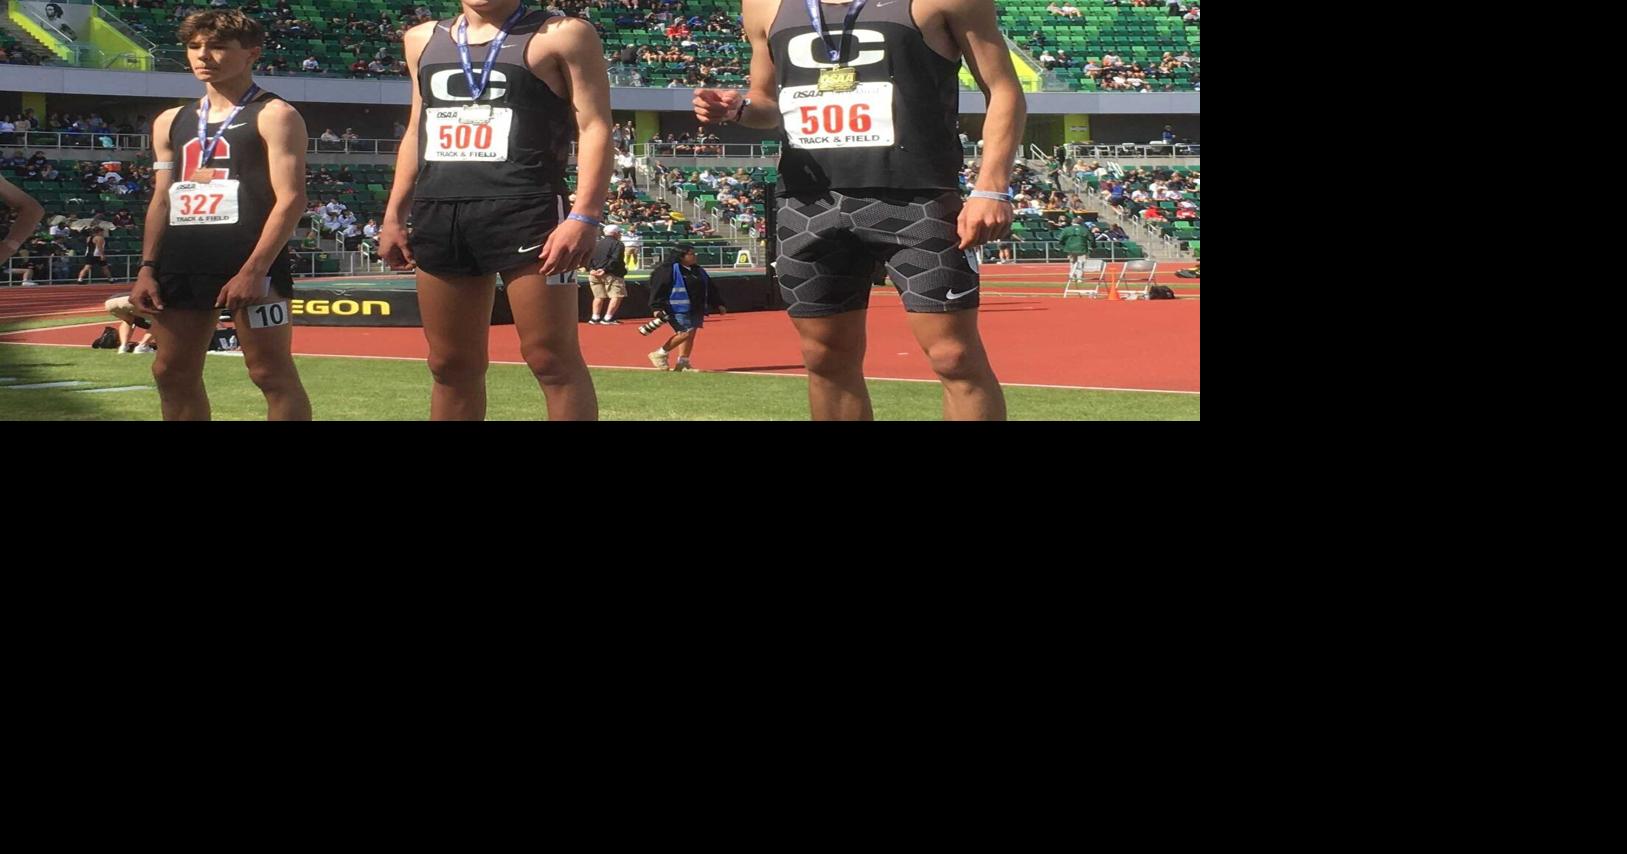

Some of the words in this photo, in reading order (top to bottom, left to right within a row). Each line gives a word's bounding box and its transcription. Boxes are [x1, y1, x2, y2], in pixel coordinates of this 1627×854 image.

[788, 29, 885, 68] C
[430, 68, 507, 101] C
[800, 103, 872, 135] 506
[440, 124, 493, 149] 500
[799, 136, 829, 145] TRACK
[845, 134, 880, 143] FIELD
[180, 194, 224, 215] 327
[255, 304, 284, 327] 10
